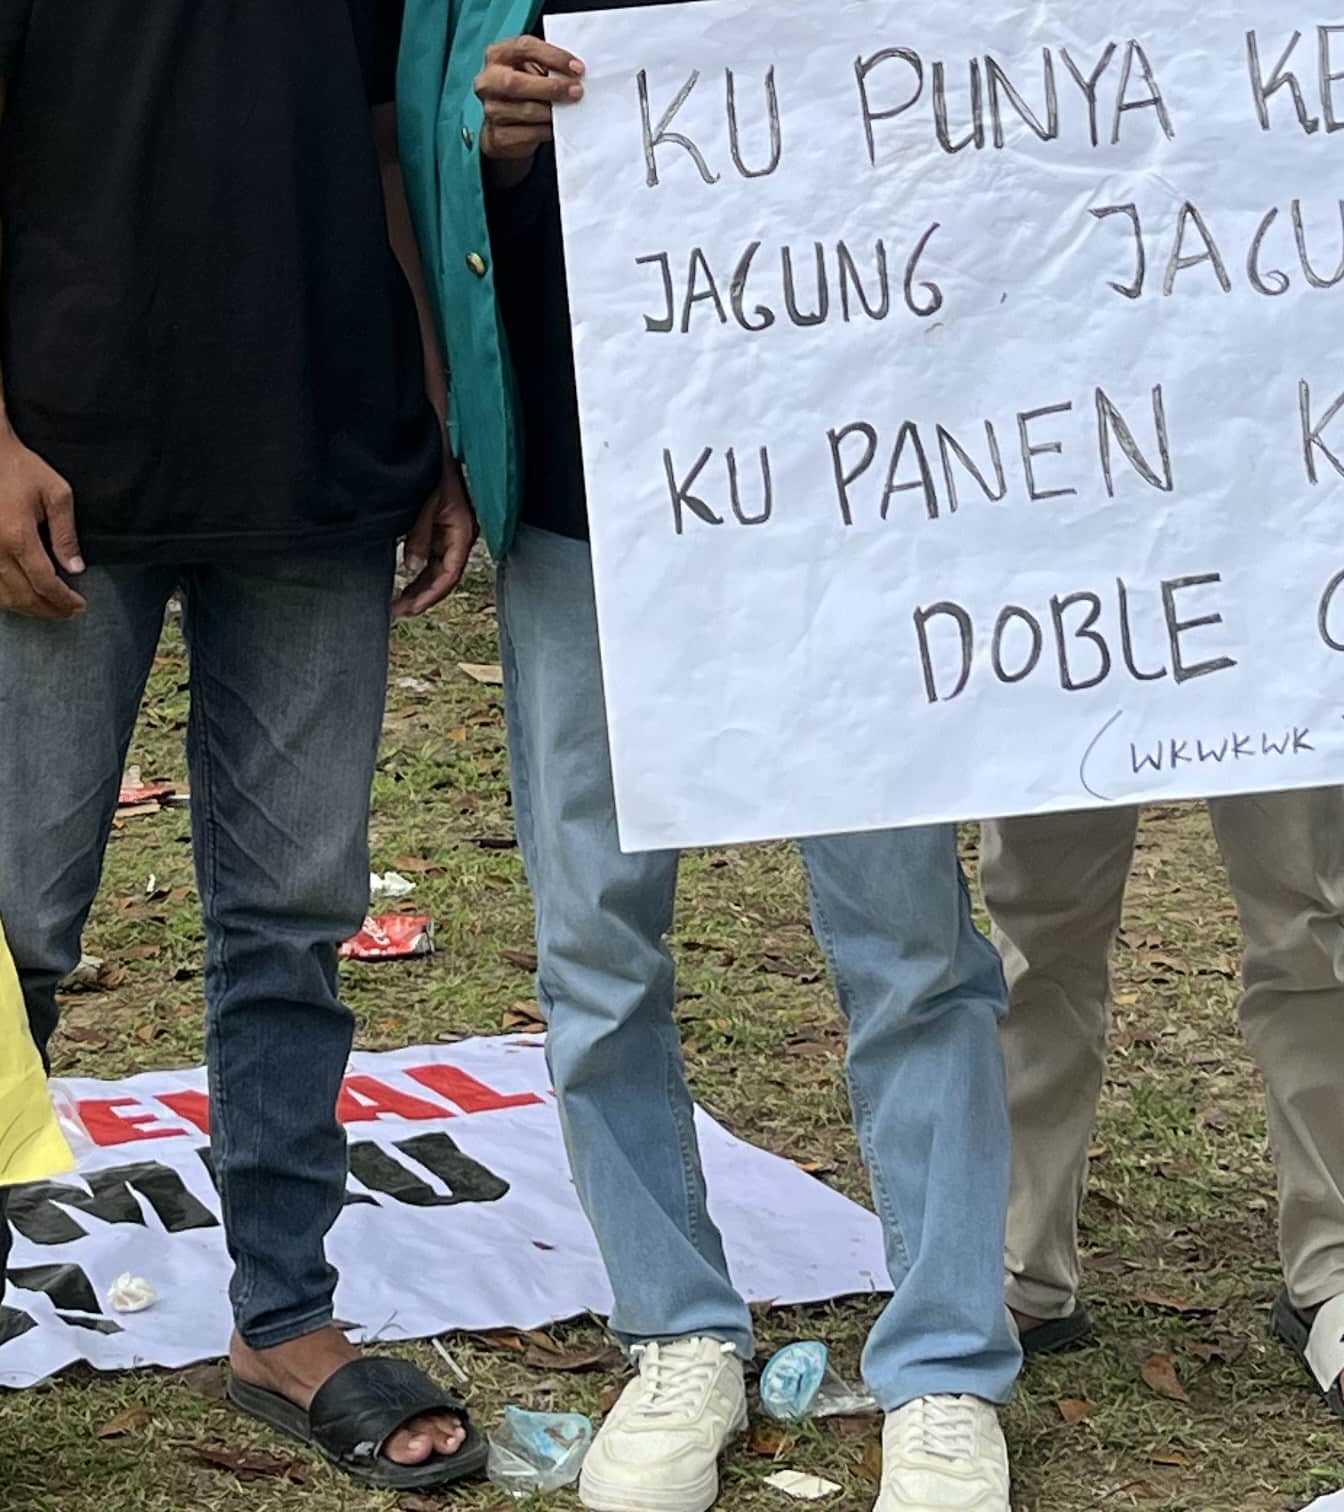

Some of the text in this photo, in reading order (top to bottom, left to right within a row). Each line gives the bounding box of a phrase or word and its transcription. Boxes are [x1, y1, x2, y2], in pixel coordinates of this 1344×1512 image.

[637, 65, 783, 188] KU
[854, 36, 1178, 166] PUNYA
[633, 222, 944, 335] JAGUNG
[662, 445, 774, 535] KU
[826, 384, 1175, 527] PANEN
[913, 572, 1238, 704] DOBLE
